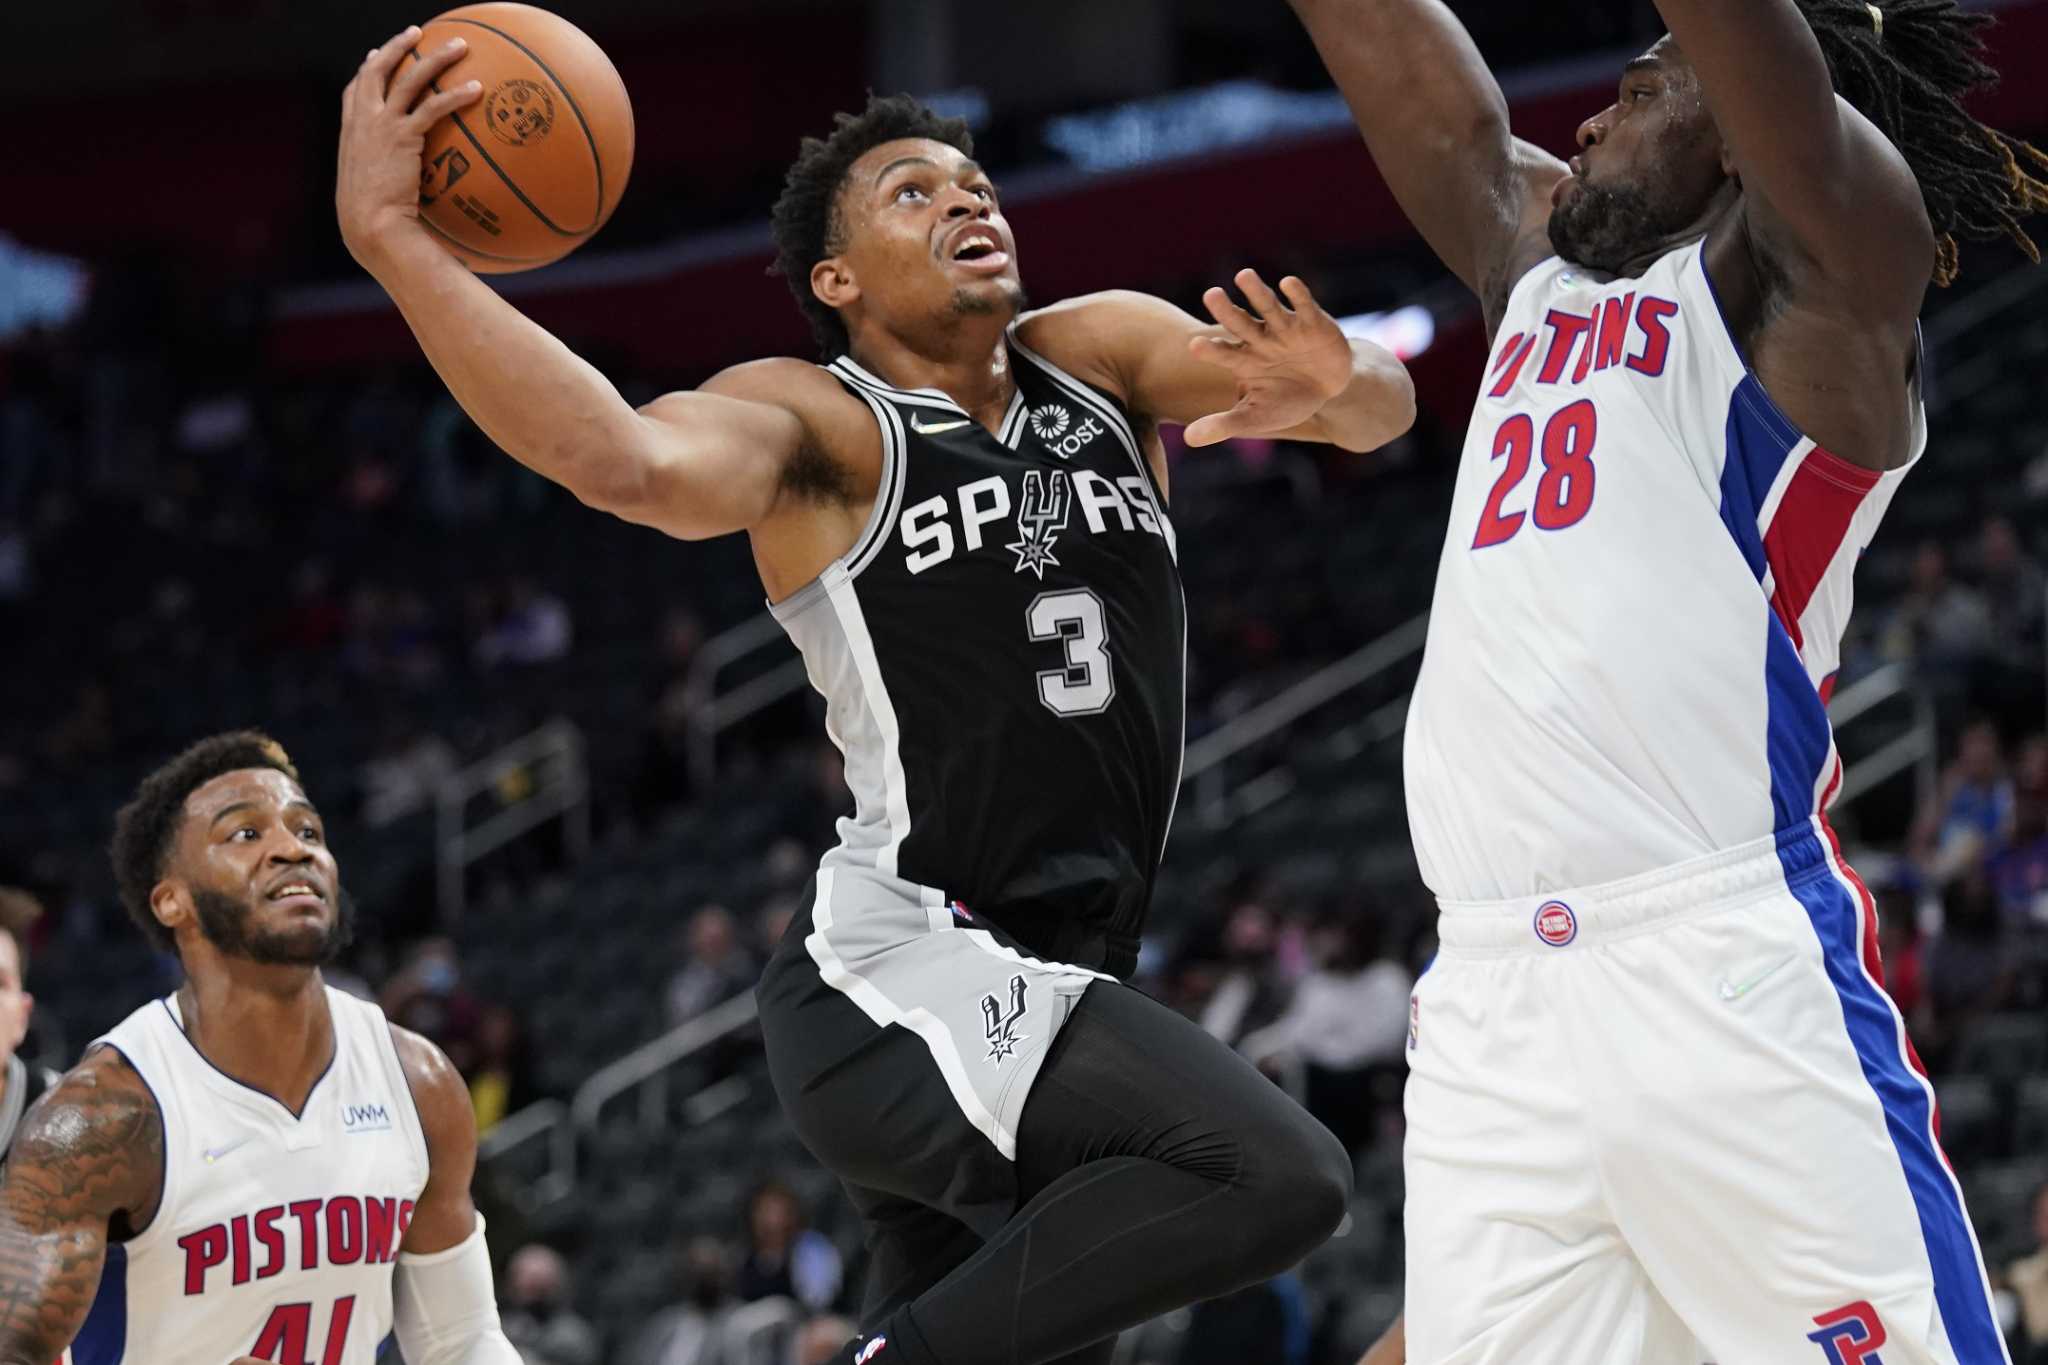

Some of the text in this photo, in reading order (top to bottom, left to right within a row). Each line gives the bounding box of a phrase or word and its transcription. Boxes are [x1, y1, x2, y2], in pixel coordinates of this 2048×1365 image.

[1471, 398, 1597, 550] 28
[1025, 586, 1116, 718] 3
[342, 1104, 391, 1127] UWM
[249, 1294, 356, 1365] 41
